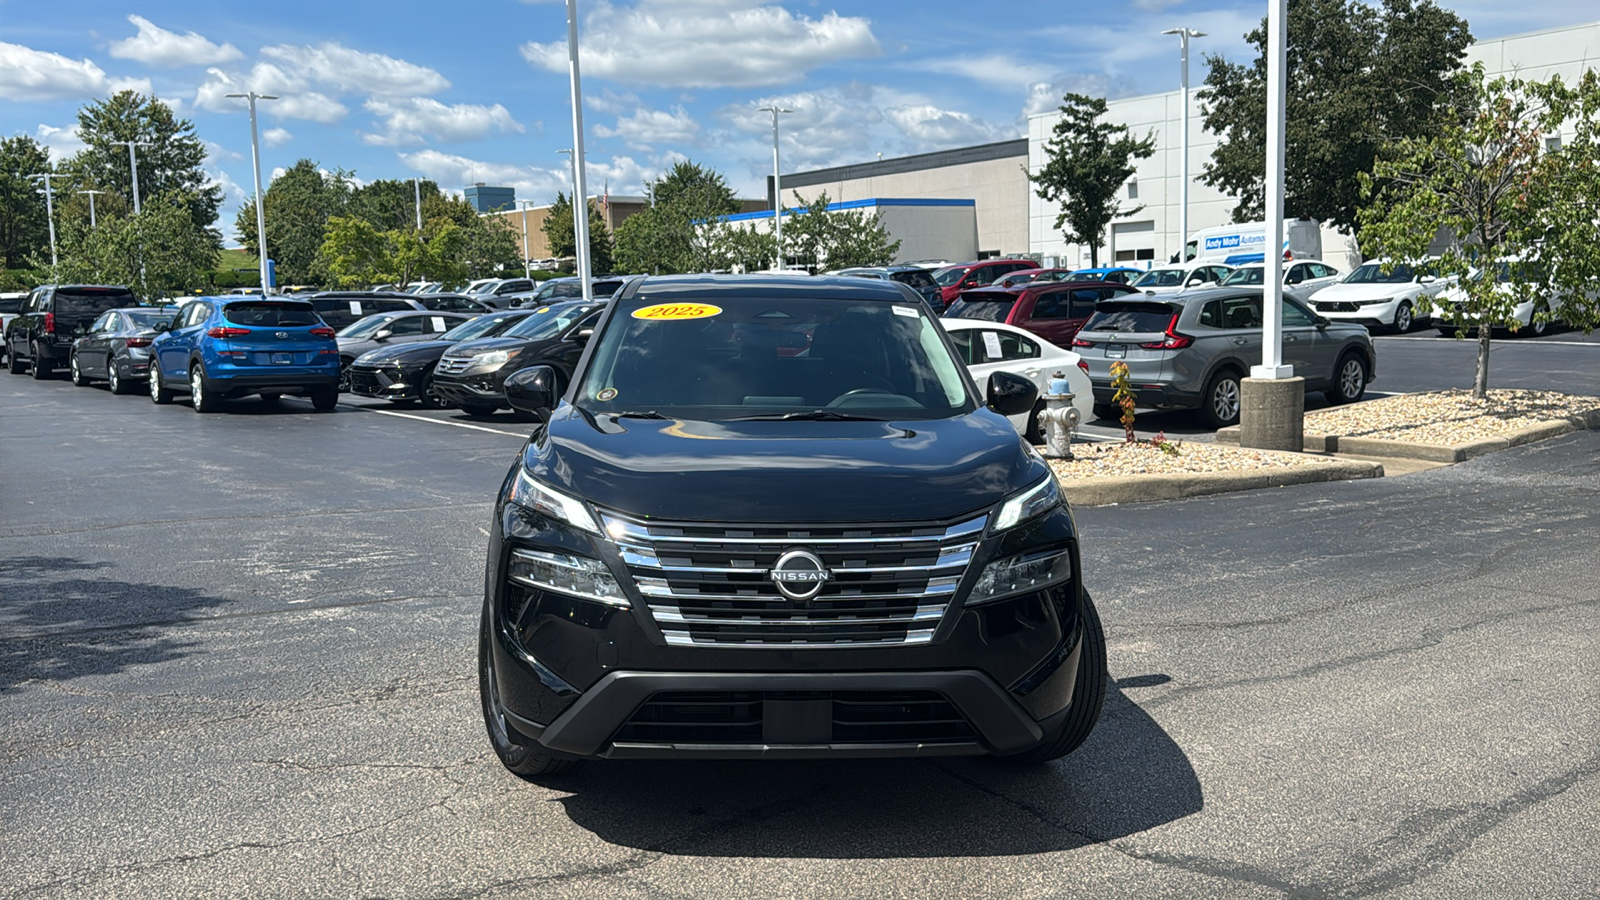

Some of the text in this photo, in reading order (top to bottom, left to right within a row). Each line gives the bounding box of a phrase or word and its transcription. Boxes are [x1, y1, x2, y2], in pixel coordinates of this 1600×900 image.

[1206, 239, 1222, 249] Andy
[1222, 237, 1239, 247] Mohr
[645, 306, 709, 318] 2025
[771, 572, 828, 581] NISSAN
